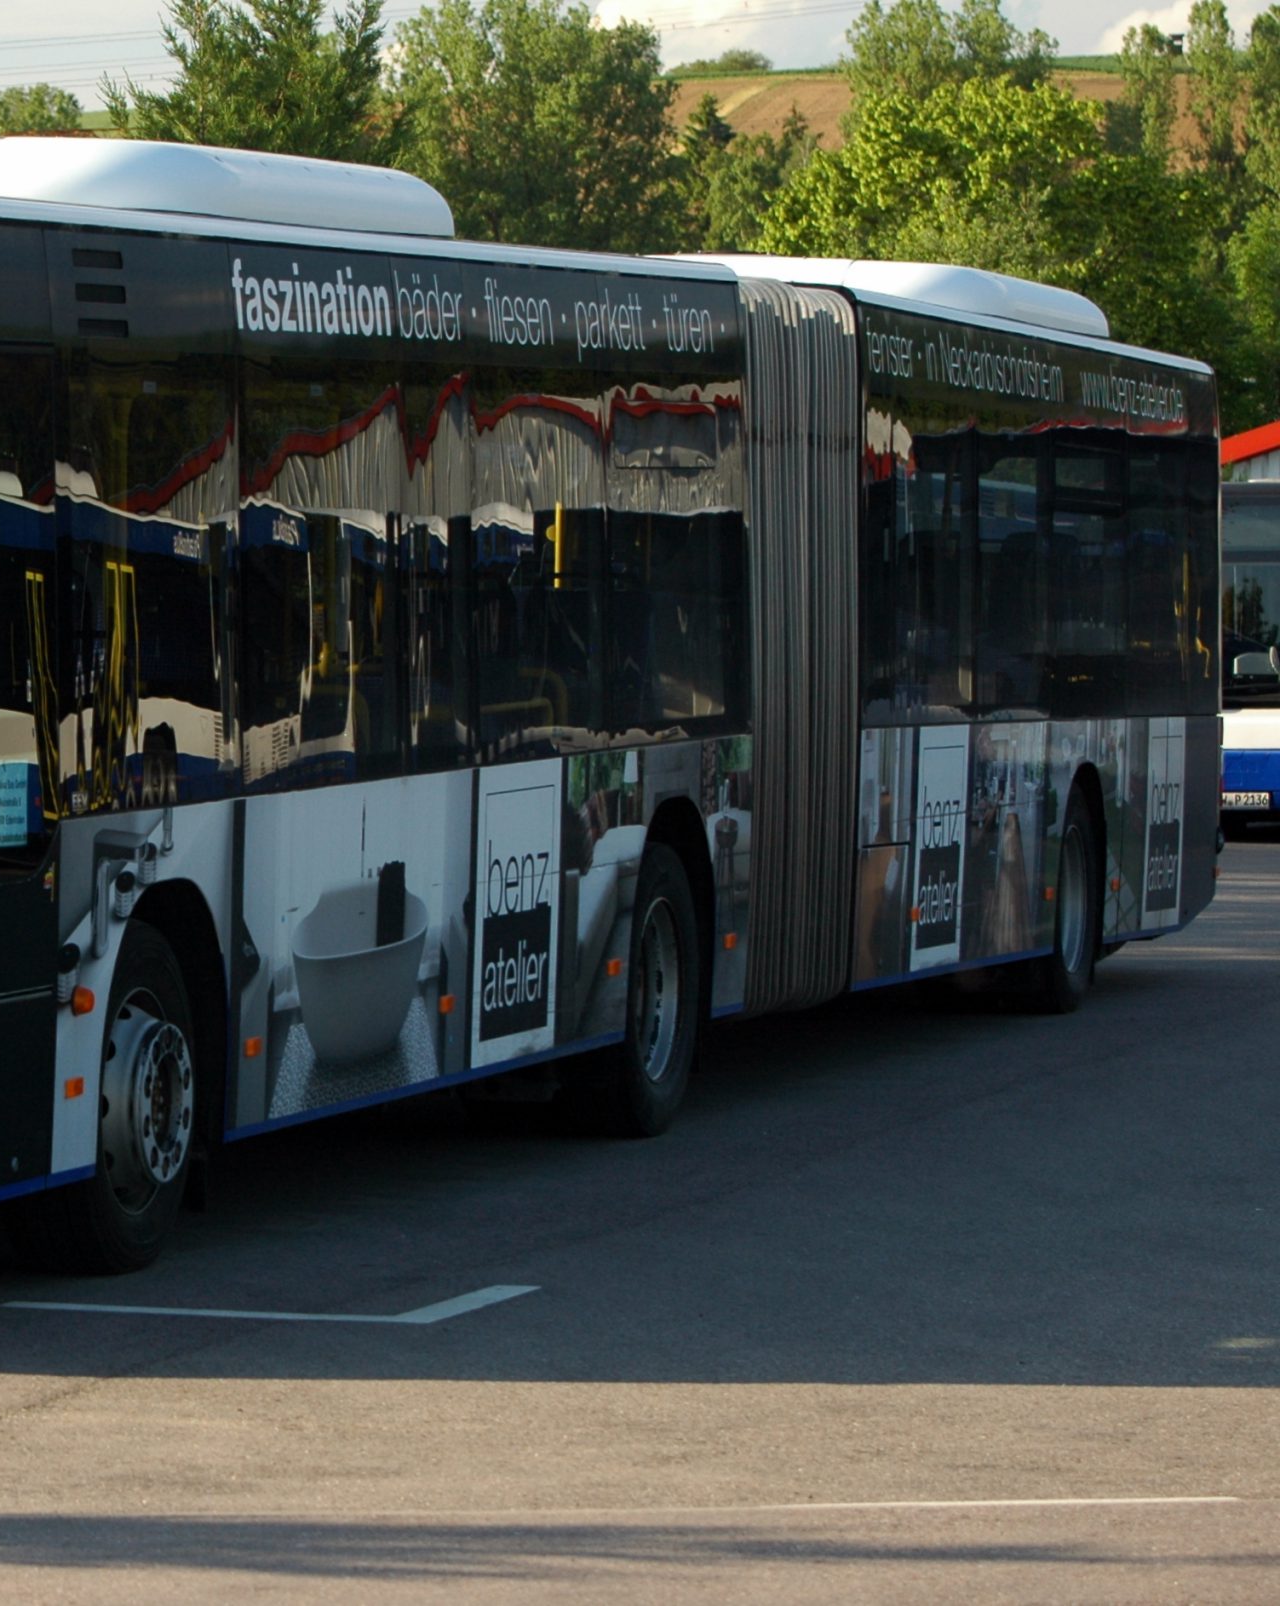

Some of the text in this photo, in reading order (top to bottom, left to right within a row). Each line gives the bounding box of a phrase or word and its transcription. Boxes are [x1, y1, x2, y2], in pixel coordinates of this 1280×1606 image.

[231, 258, 715, 363] faszination bäder fliesen parkett türen
[865, 317, 1184, 424] fenster in Neckarbischofsheim www.benz-atelier.de
[922, 786, 960, 849] benz
[1150, 771, 1180, 824] benz
[1235, 794, 1241, 806] P
[1243, 793, 1268, 806] 2136
[486, 840, 550, 920] benz
[918, 870, 958, 926] atelier
[1147, 844, 1179, 892] atelier
[484, 940, 548, 1013] atelier
